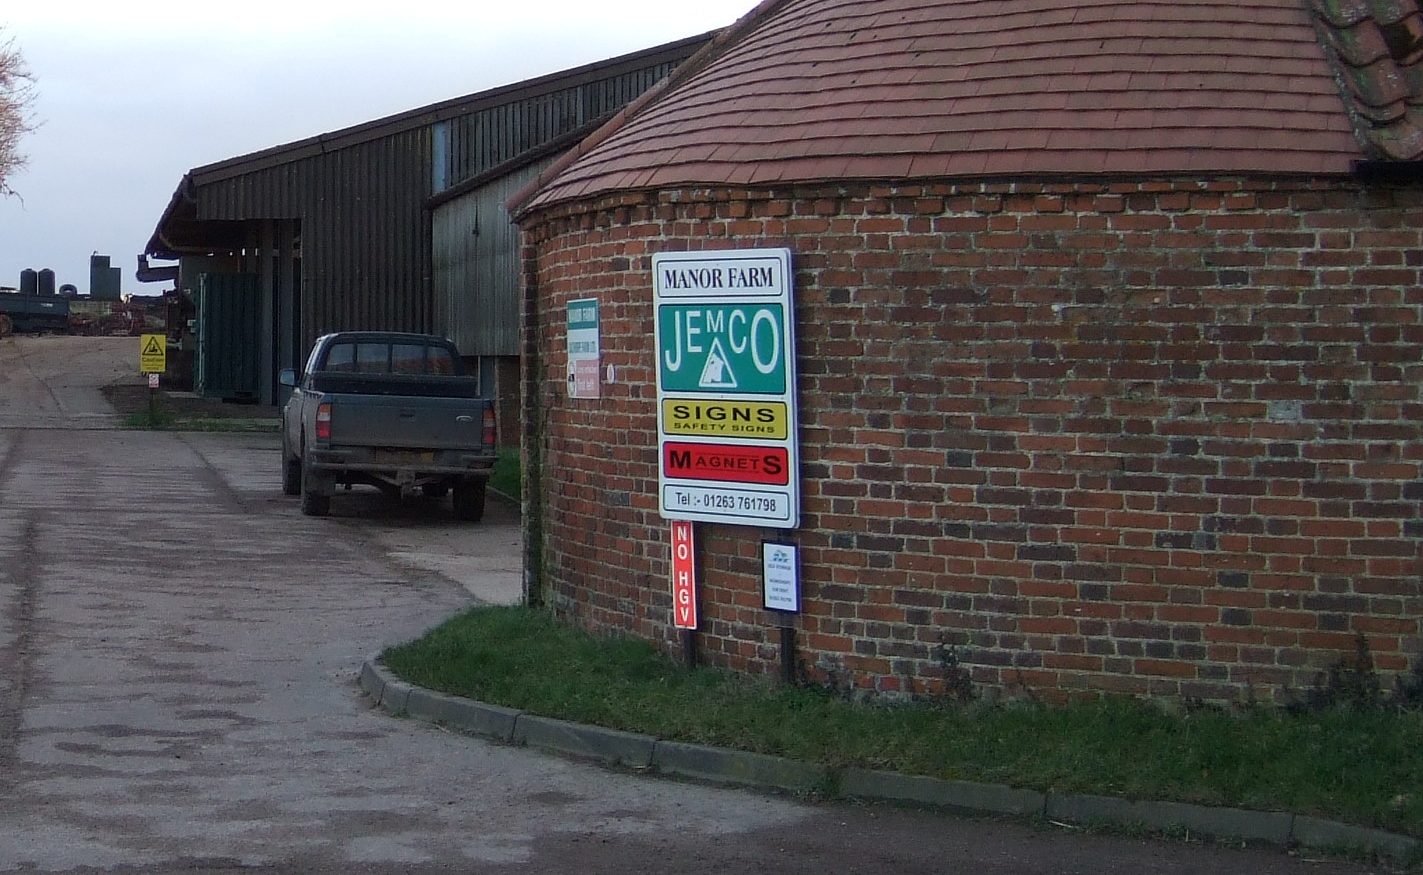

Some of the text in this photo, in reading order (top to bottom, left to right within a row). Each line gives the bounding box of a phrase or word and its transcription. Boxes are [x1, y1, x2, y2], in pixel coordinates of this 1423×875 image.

[664, 267, 774, 289] MANOR FARM
[664, 308, 779, 374] JEMCO
[673, 405, 775, 423] SIGNS
[673, 422, 776, 433] SAFETY SIGNS
[675, 492, 691, 505] Tel
[703, 494, 735, 509] 01263
[737, 496, 777, 512] 761798
[677, 525, 689, 623] NO HGV
